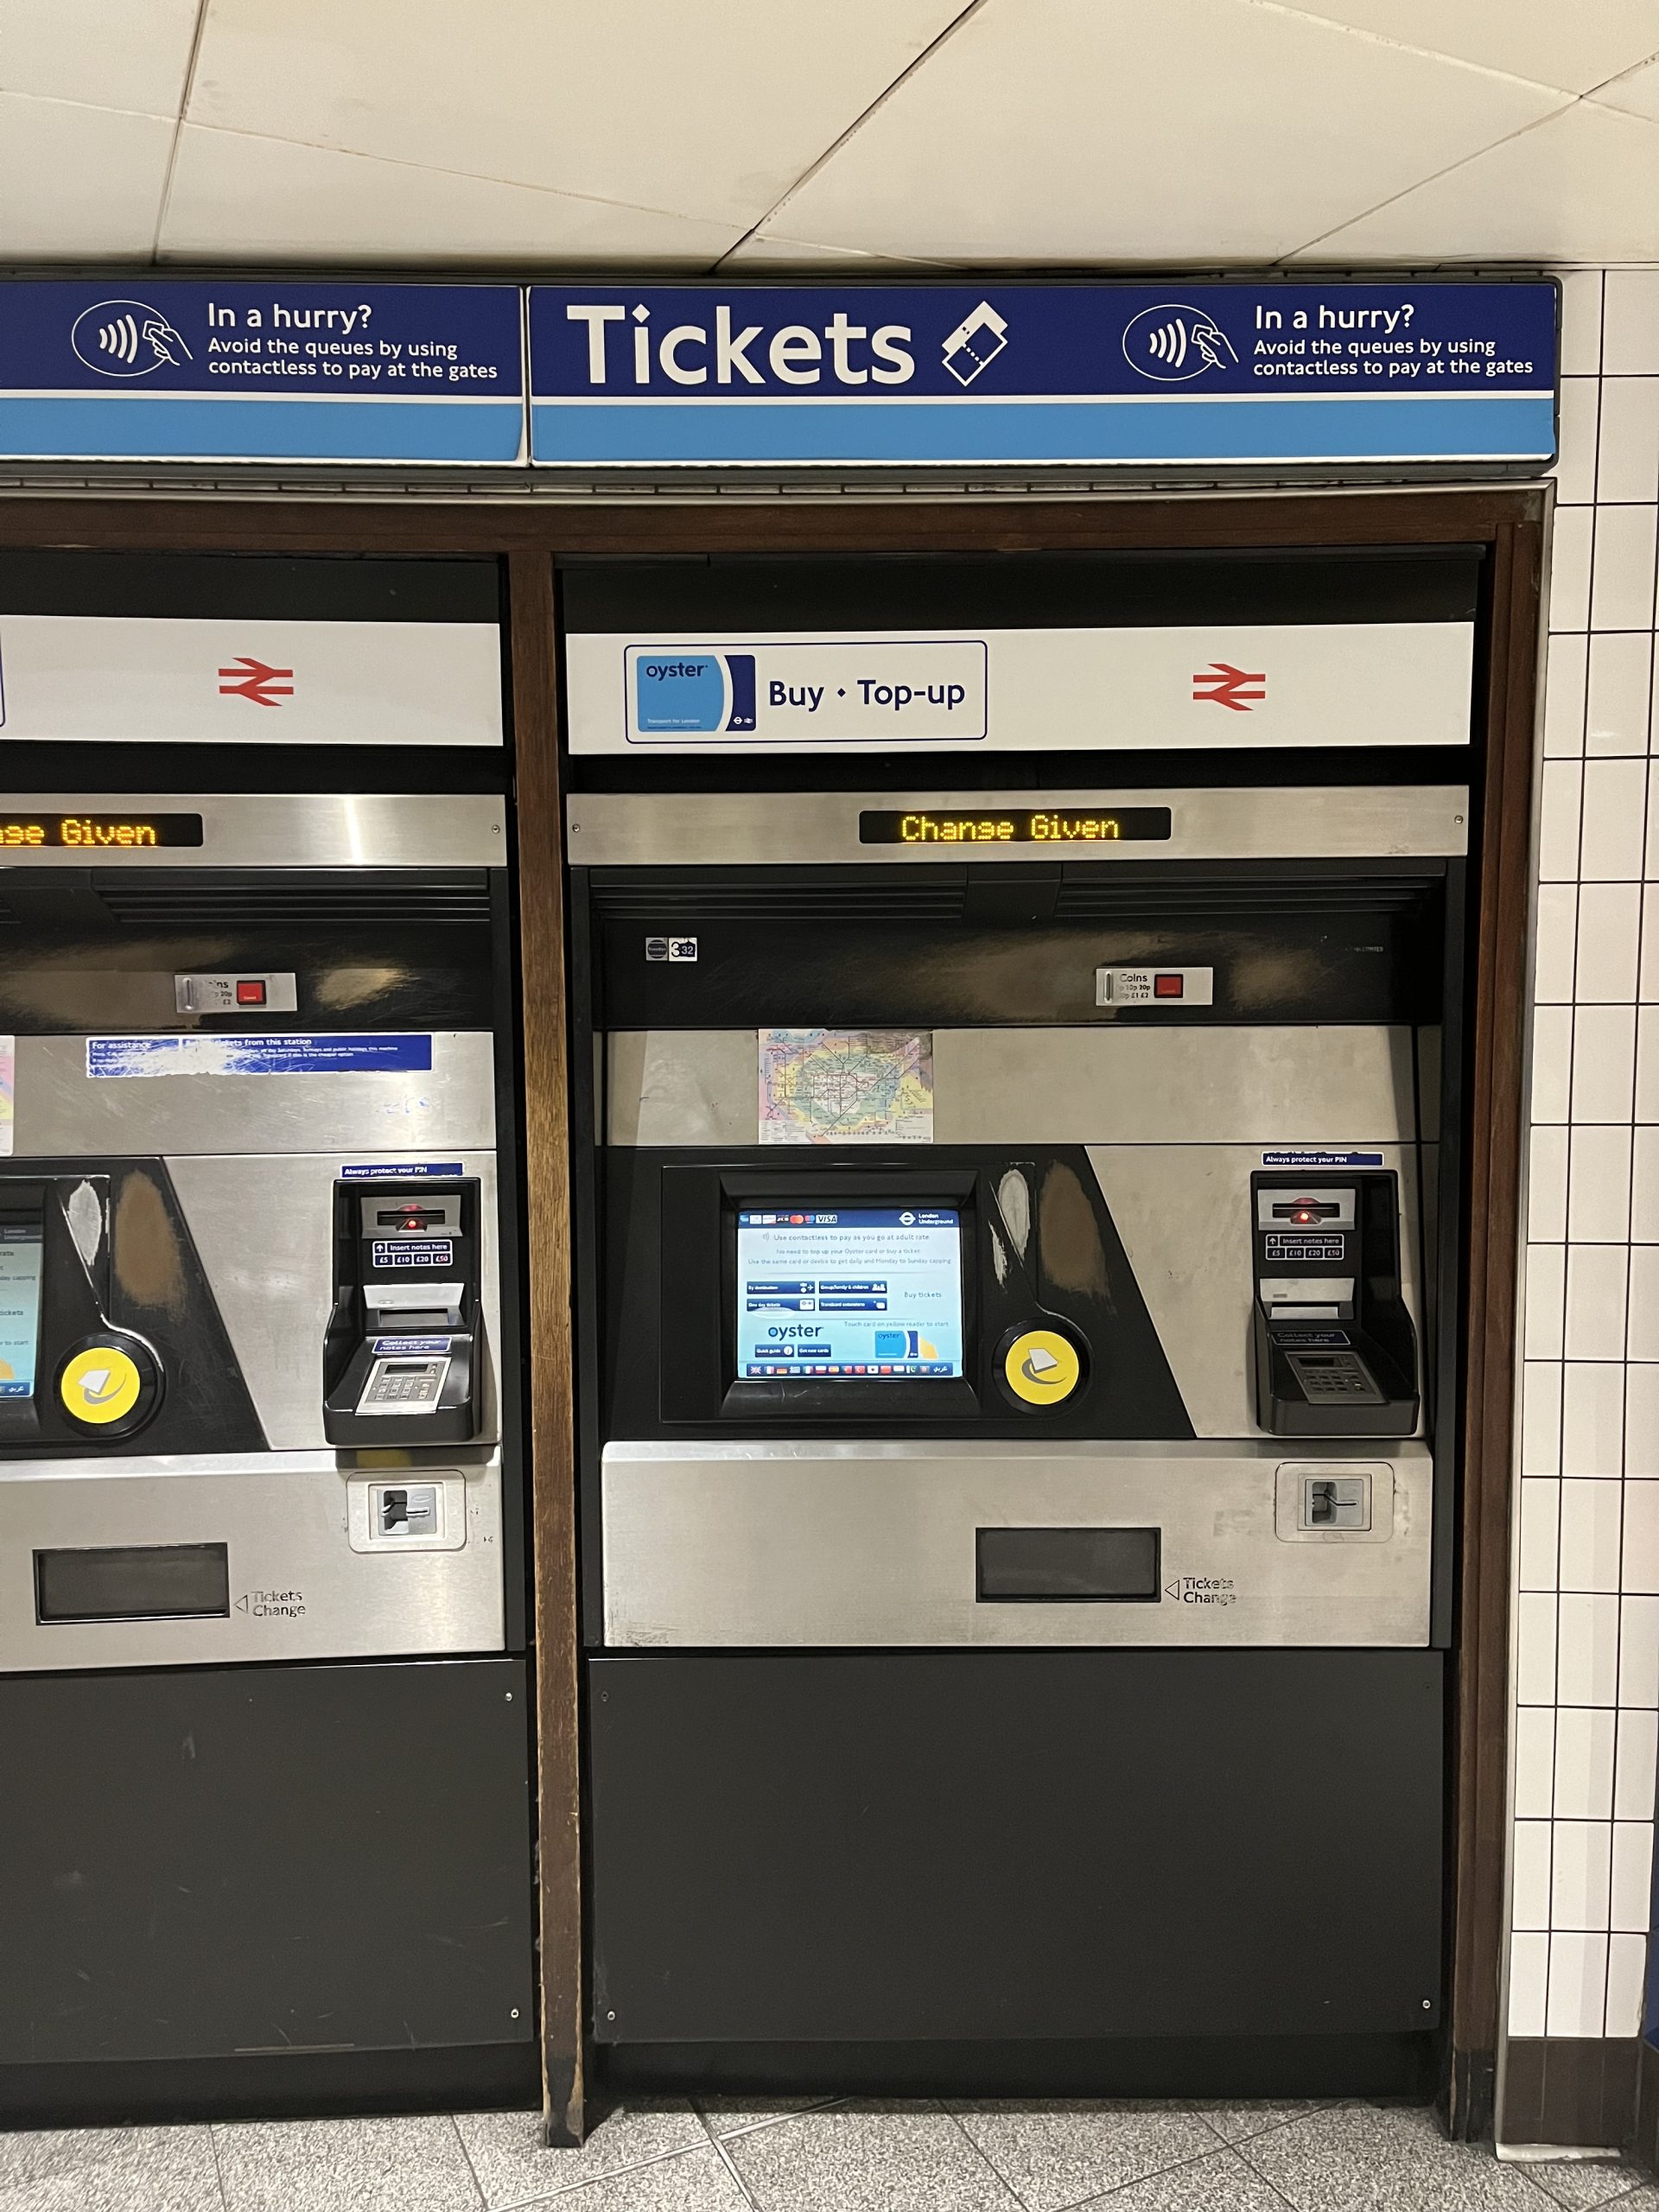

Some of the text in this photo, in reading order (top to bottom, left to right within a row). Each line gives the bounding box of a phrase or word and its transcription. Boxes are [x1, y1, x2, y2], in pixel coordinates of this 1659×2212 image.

[208, 302, 372, 334] In a hurry?
[1255, 304, 1414, 334] In a hurry?
[208, 338, 458, 360] Avoid the queues by using
[567, 303, 915, 385] Tickets
[1254, 338, 1496, 357] Avoid the queues by using
[208, 359, 498, 382] contactless to pay at the gates
[1254, 359, 1534, 378] contactless to pay at the gates
[645, 662, 707, 681] oyster
[769, 679, 965, 712] Buy Top-up
[61, 819, 156, 845] Given
[902, 814, 1119, 842] Change Given
[1119, 973, 1148, 982] Coins
[817, 1215, 836, 1224] VISA
[768, 1324, 823, 1341] oyster
[1182, 1577, 1234, 1590] Tickets
[251, 1591, 302, 1603] Tickets
[1183, 1592, 1236, 1606] Change
[252, 1605, 306, 1618] Change
